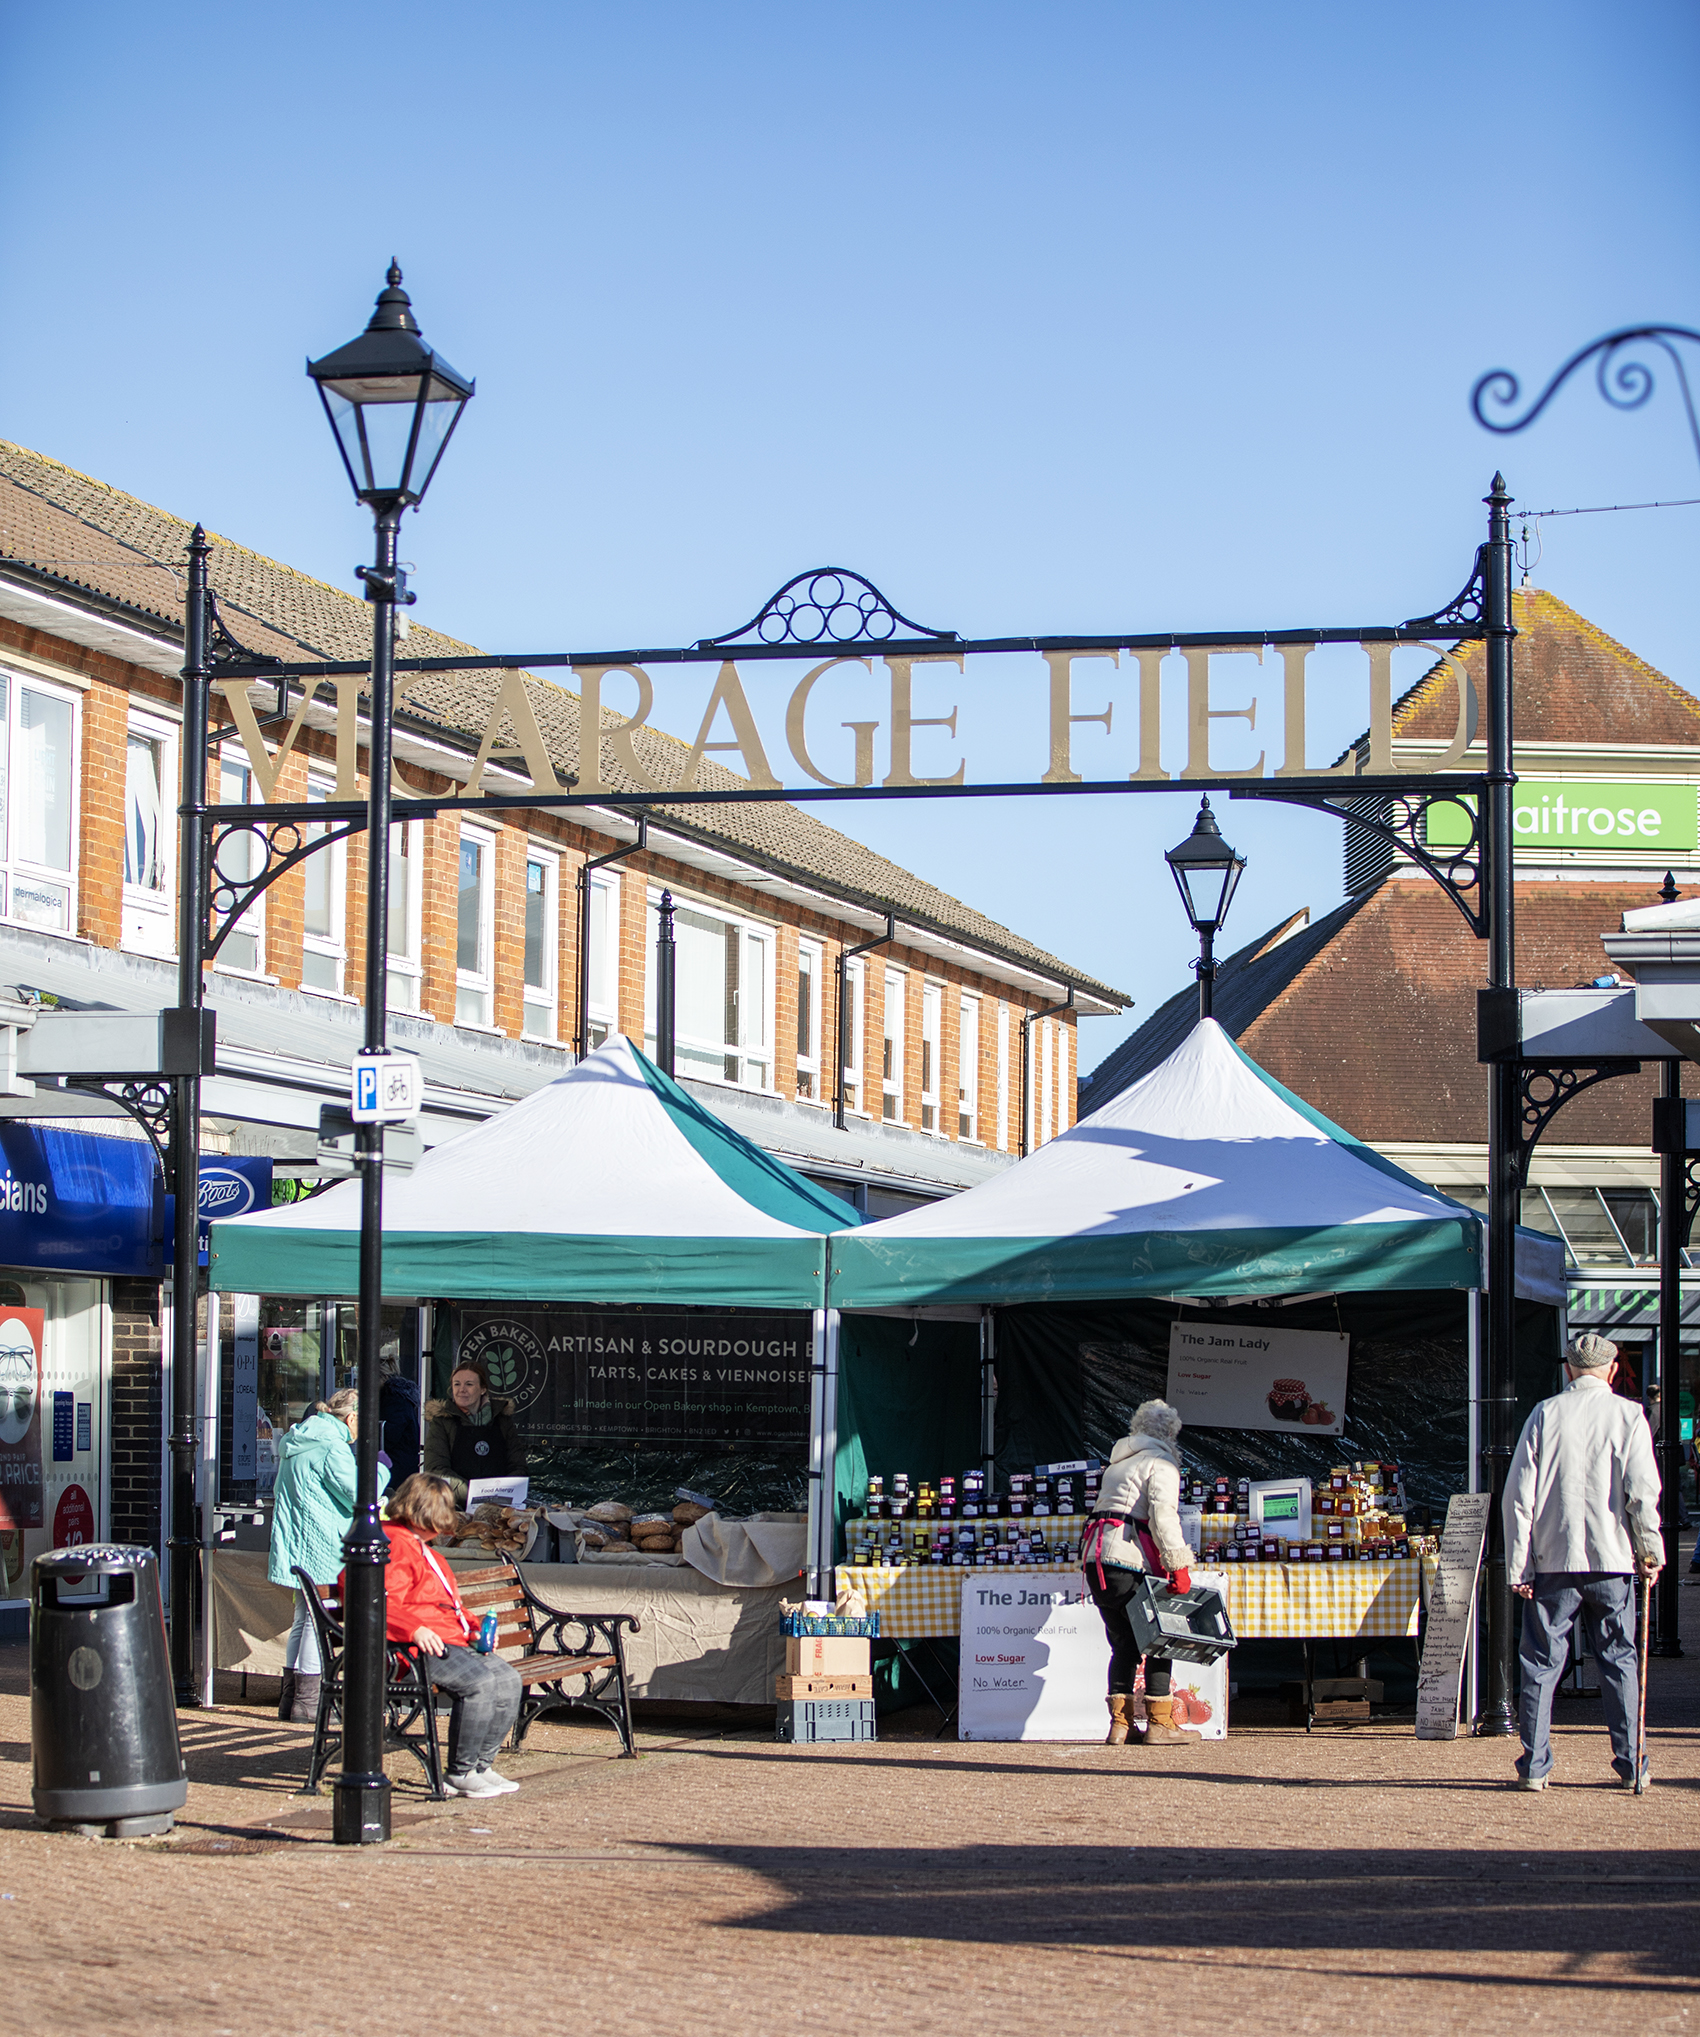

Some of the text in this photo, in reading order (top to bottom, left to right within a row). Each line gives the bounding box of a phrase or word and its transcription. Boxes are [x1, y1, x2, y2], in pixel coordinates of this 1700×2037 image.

[215, 640, 1479, 804] VICARAGE FIELD
[1464, 792, 1662, 837] aitrose
[15, 886, 63, 908] dermalogica
[360, 1069, 376, 1109] P
[199, 1179, 240, 1209] Boots
[461, 1325, 542, 1364] PEN BAKERY
[547, 1335, 635, 1354] ARTISAN
[641, 1340, 652, 1354] &
[658, 1338, 798, 1357] SOURDOUGH
[1180, 1333, 1271, 1352] The Jam Lady
[1196, 1356, 1219, 1365] Organic
[589, 1365, 641, 1382] TARTS,
[646, 1367, 698, 1381] CAKES
[702, 1369, 712, 1381] &
[1177, 1371, 1212, 1381] Low Sugar
[573, 1398, 584, 1409] all
[586, 1399, 612, 1409] made
[614, 1400, 624, 1410] in
[625, 1401, 641, 1410] our
[643, 1400, 671, 1413] Open
[673, 1401, 706, 1413] Bakery
[708, 1402, 732, 1414] shop
[734, 1402, 743, 1412] in
[746, 1403, 802, 1415] Kemptown,
[526, 1423, 536, 1431] 34
[598, 1425, 639, 1433] KEMPTOWN
[645, 1426, 682, 1435] BRIGHTON
[688, 1427, 702, 1436] BN2
[5, 1463, 39, 1486] PRICE
[62, 1502, 85, 1515] additional
[68, 1516, 80, 1529] pairs
[976, 1590, 1012, 1606] The
[1017, 1590, 1057, 1606] Jam
[976, 1625, 1078, 1637] 100% Organic Real Fruit
[975, 1653, 1026, 1665] Low Sugar
[973, 1677, 1025, 1688] No Water
